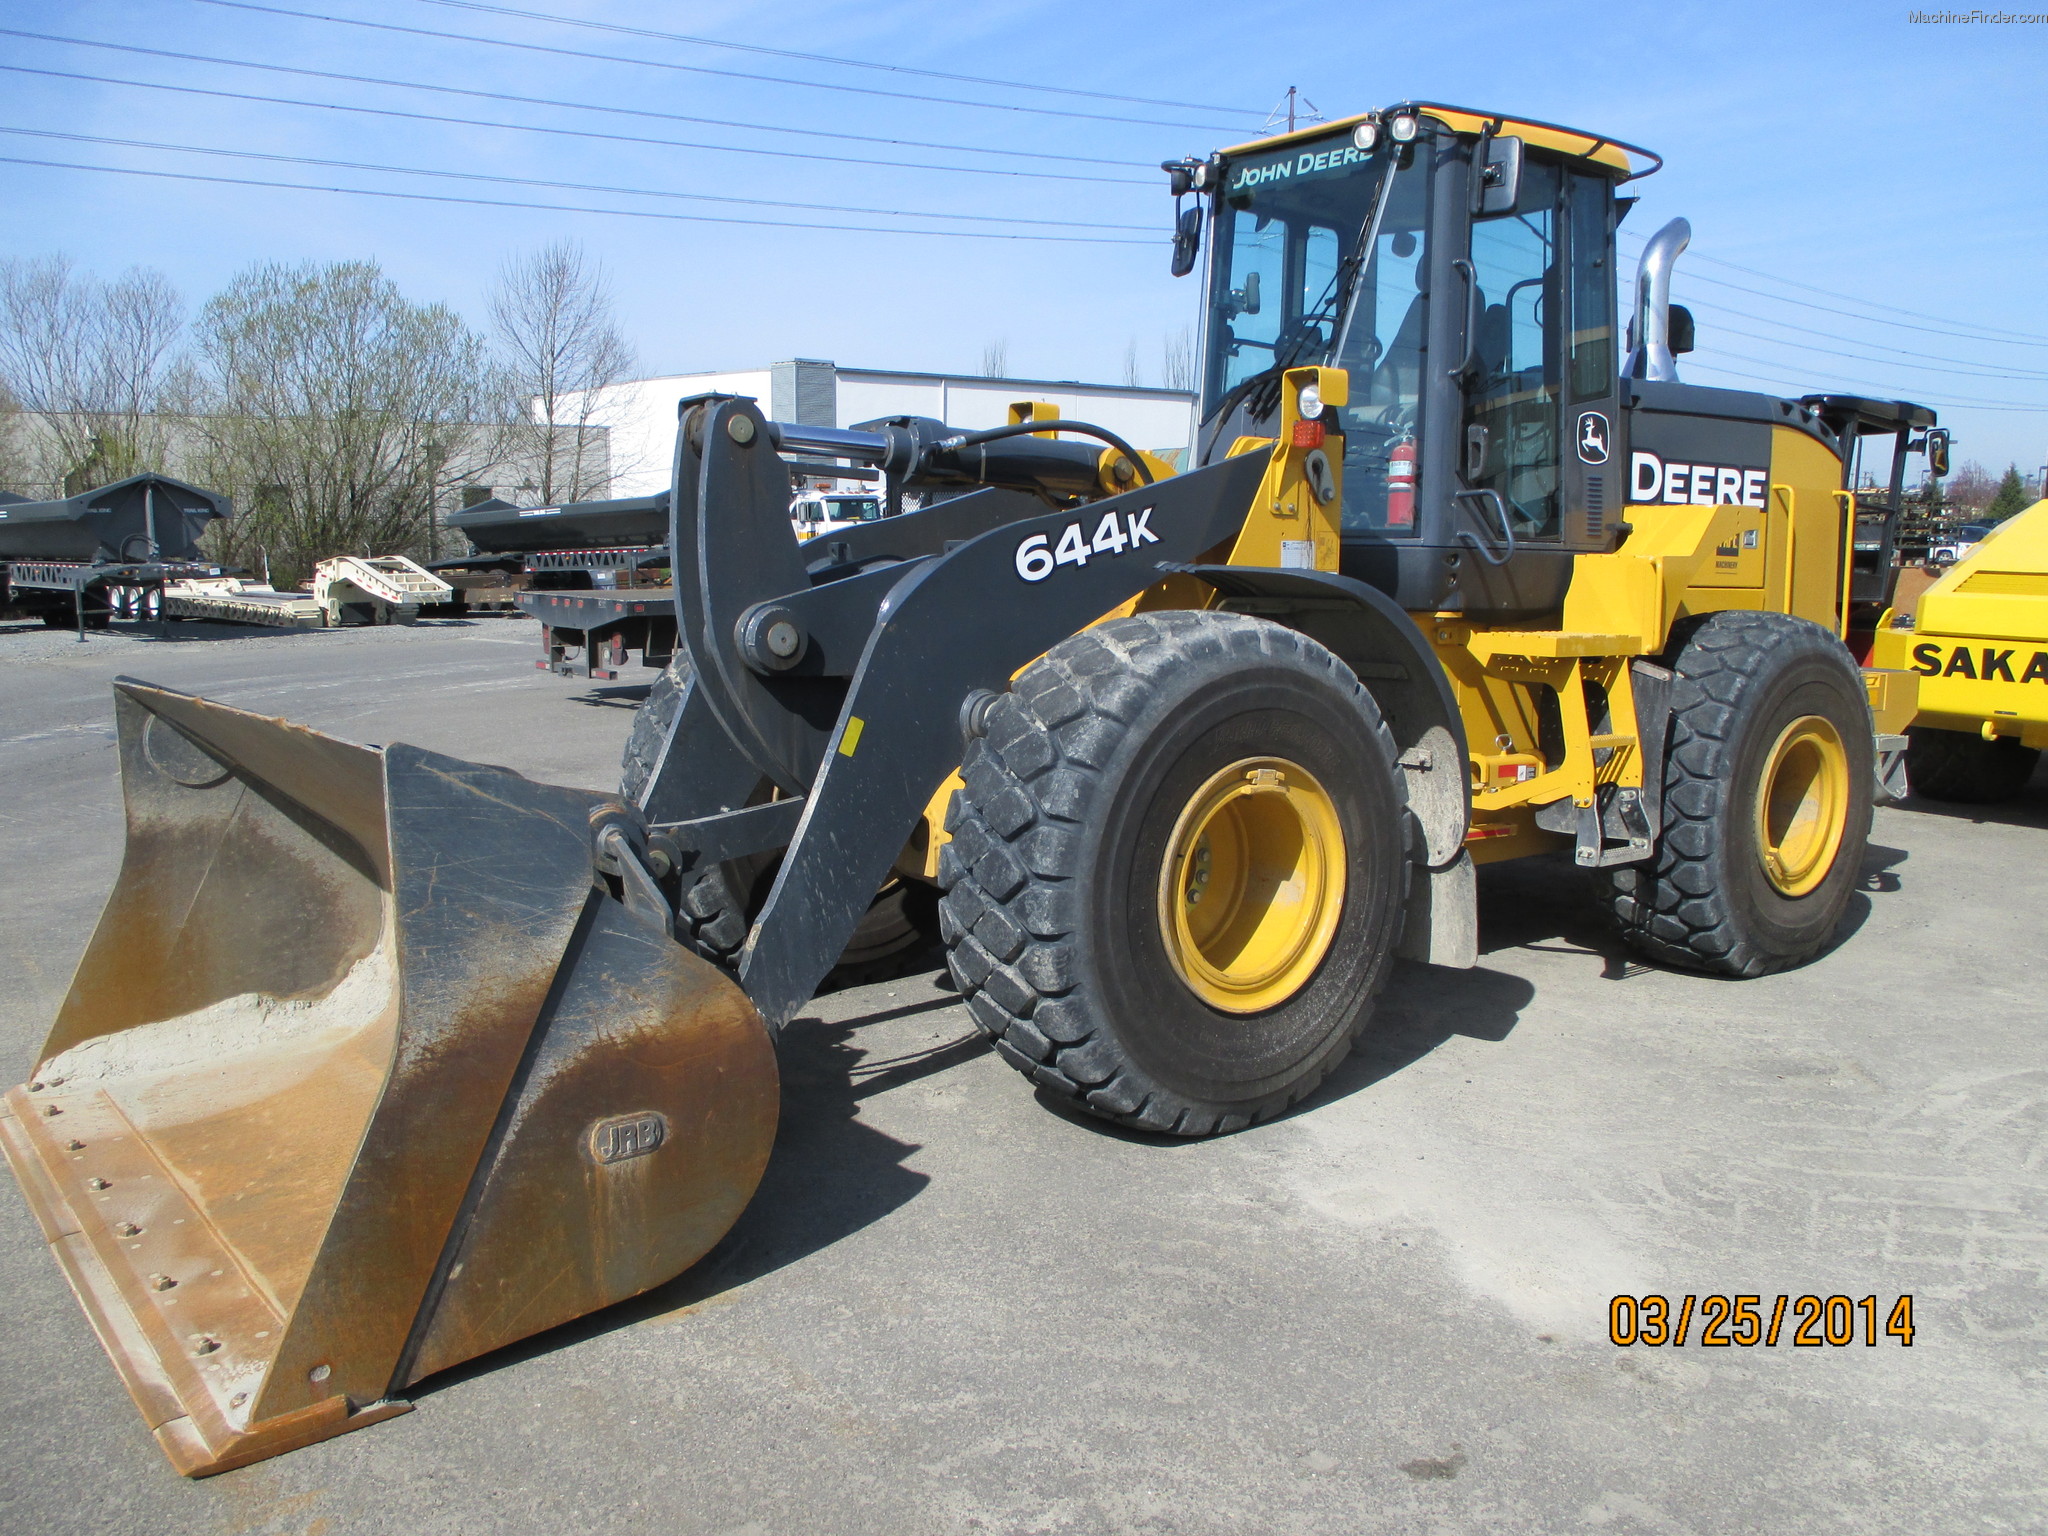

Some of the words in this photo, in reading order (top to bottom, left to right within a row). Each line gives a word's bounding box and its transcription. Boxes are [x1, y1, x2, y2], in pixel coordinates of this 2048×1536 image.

[1232, 160, 1292, 190] JOHN
[1630, 451, 1767, 509] DEERE
[1014, 506, 1161, 583] 644K
[1910, 642, 2048, 685] SAKA
[601, 1119, 657, 1158] JRB
